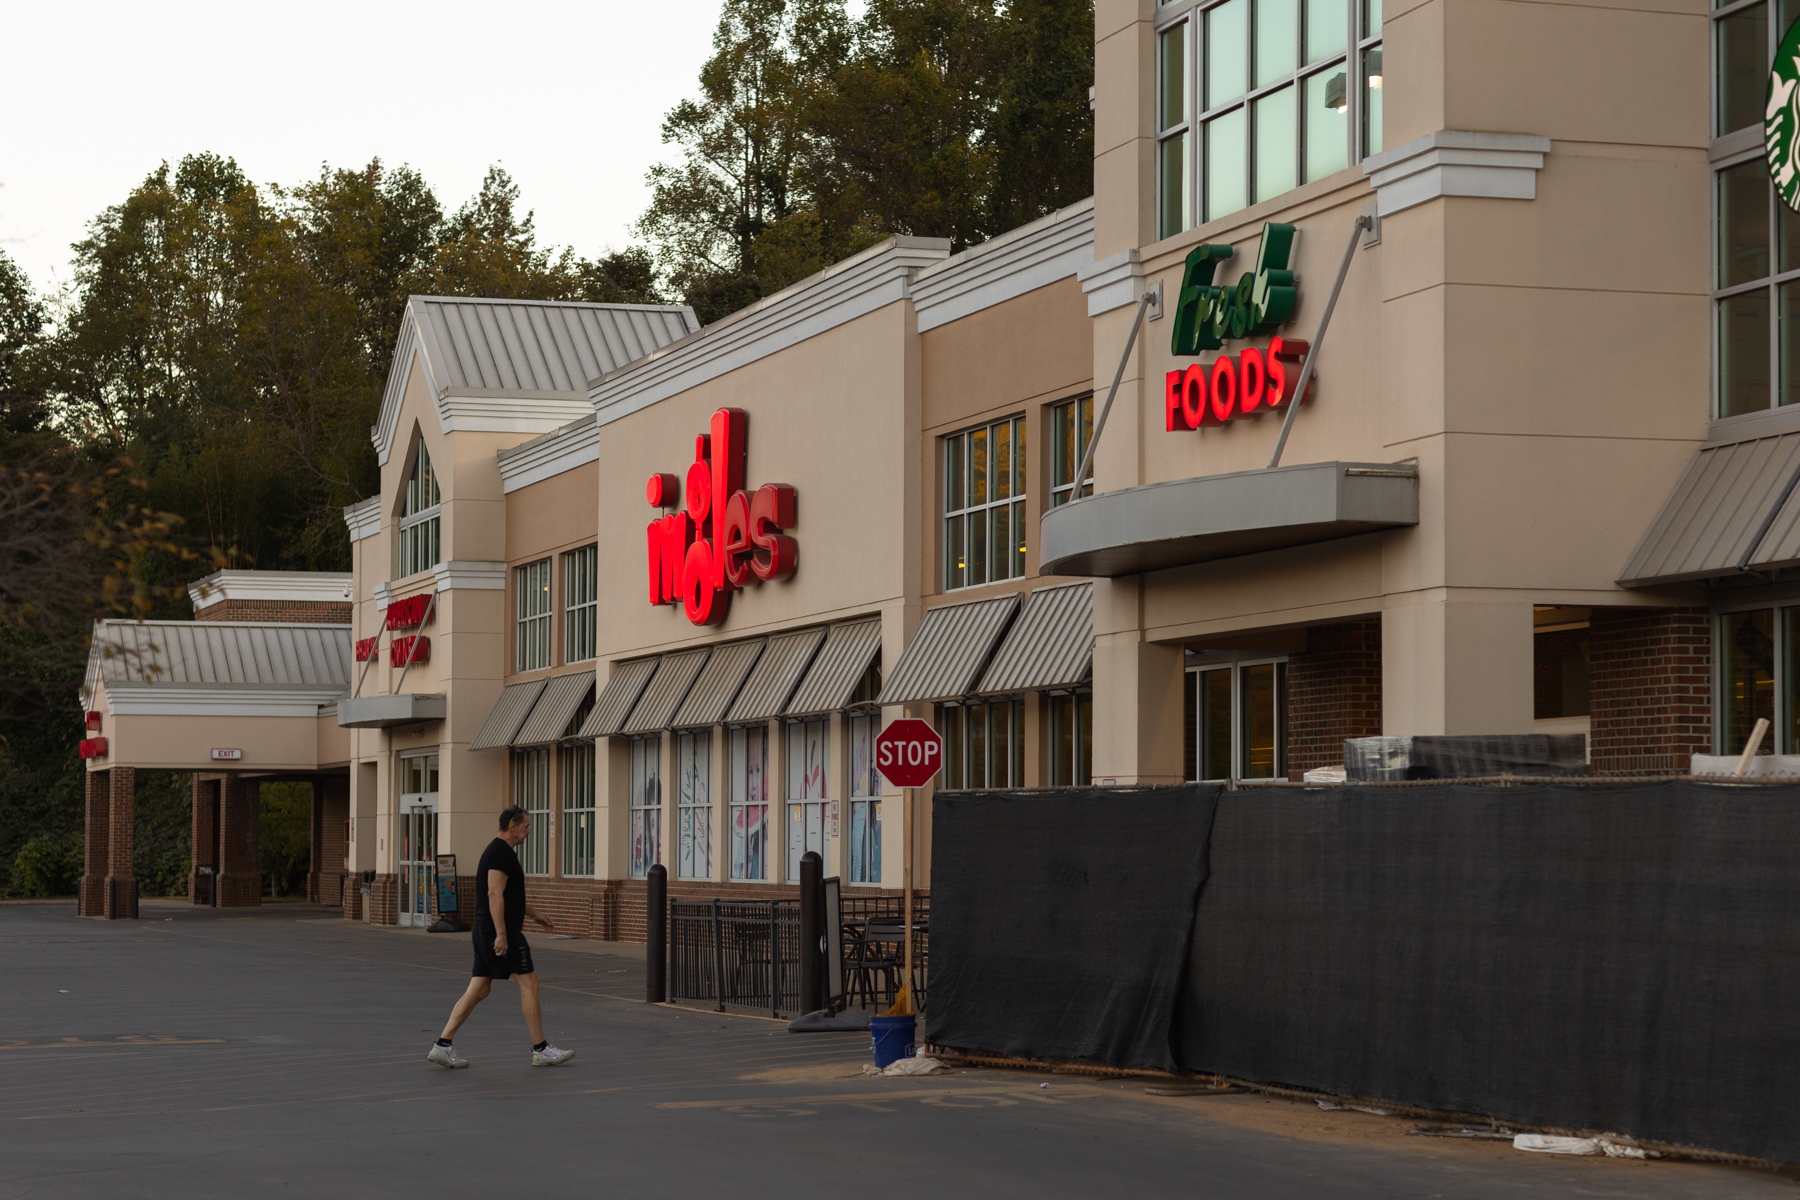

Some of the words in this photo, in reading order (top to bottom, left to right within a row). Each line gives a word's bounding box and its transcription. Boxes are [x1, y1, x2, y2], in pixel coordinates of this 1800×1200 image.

[1171, 222, 1296, 356] Fresh
[1166, 336, 1307, 432] FOODS
[386, 594, 430, 631] AMERICAN
[390, 636, 425, 668] OWNED
[218, 750, 235, 758] EXIT
[878, 740, 938, 767] STOP
